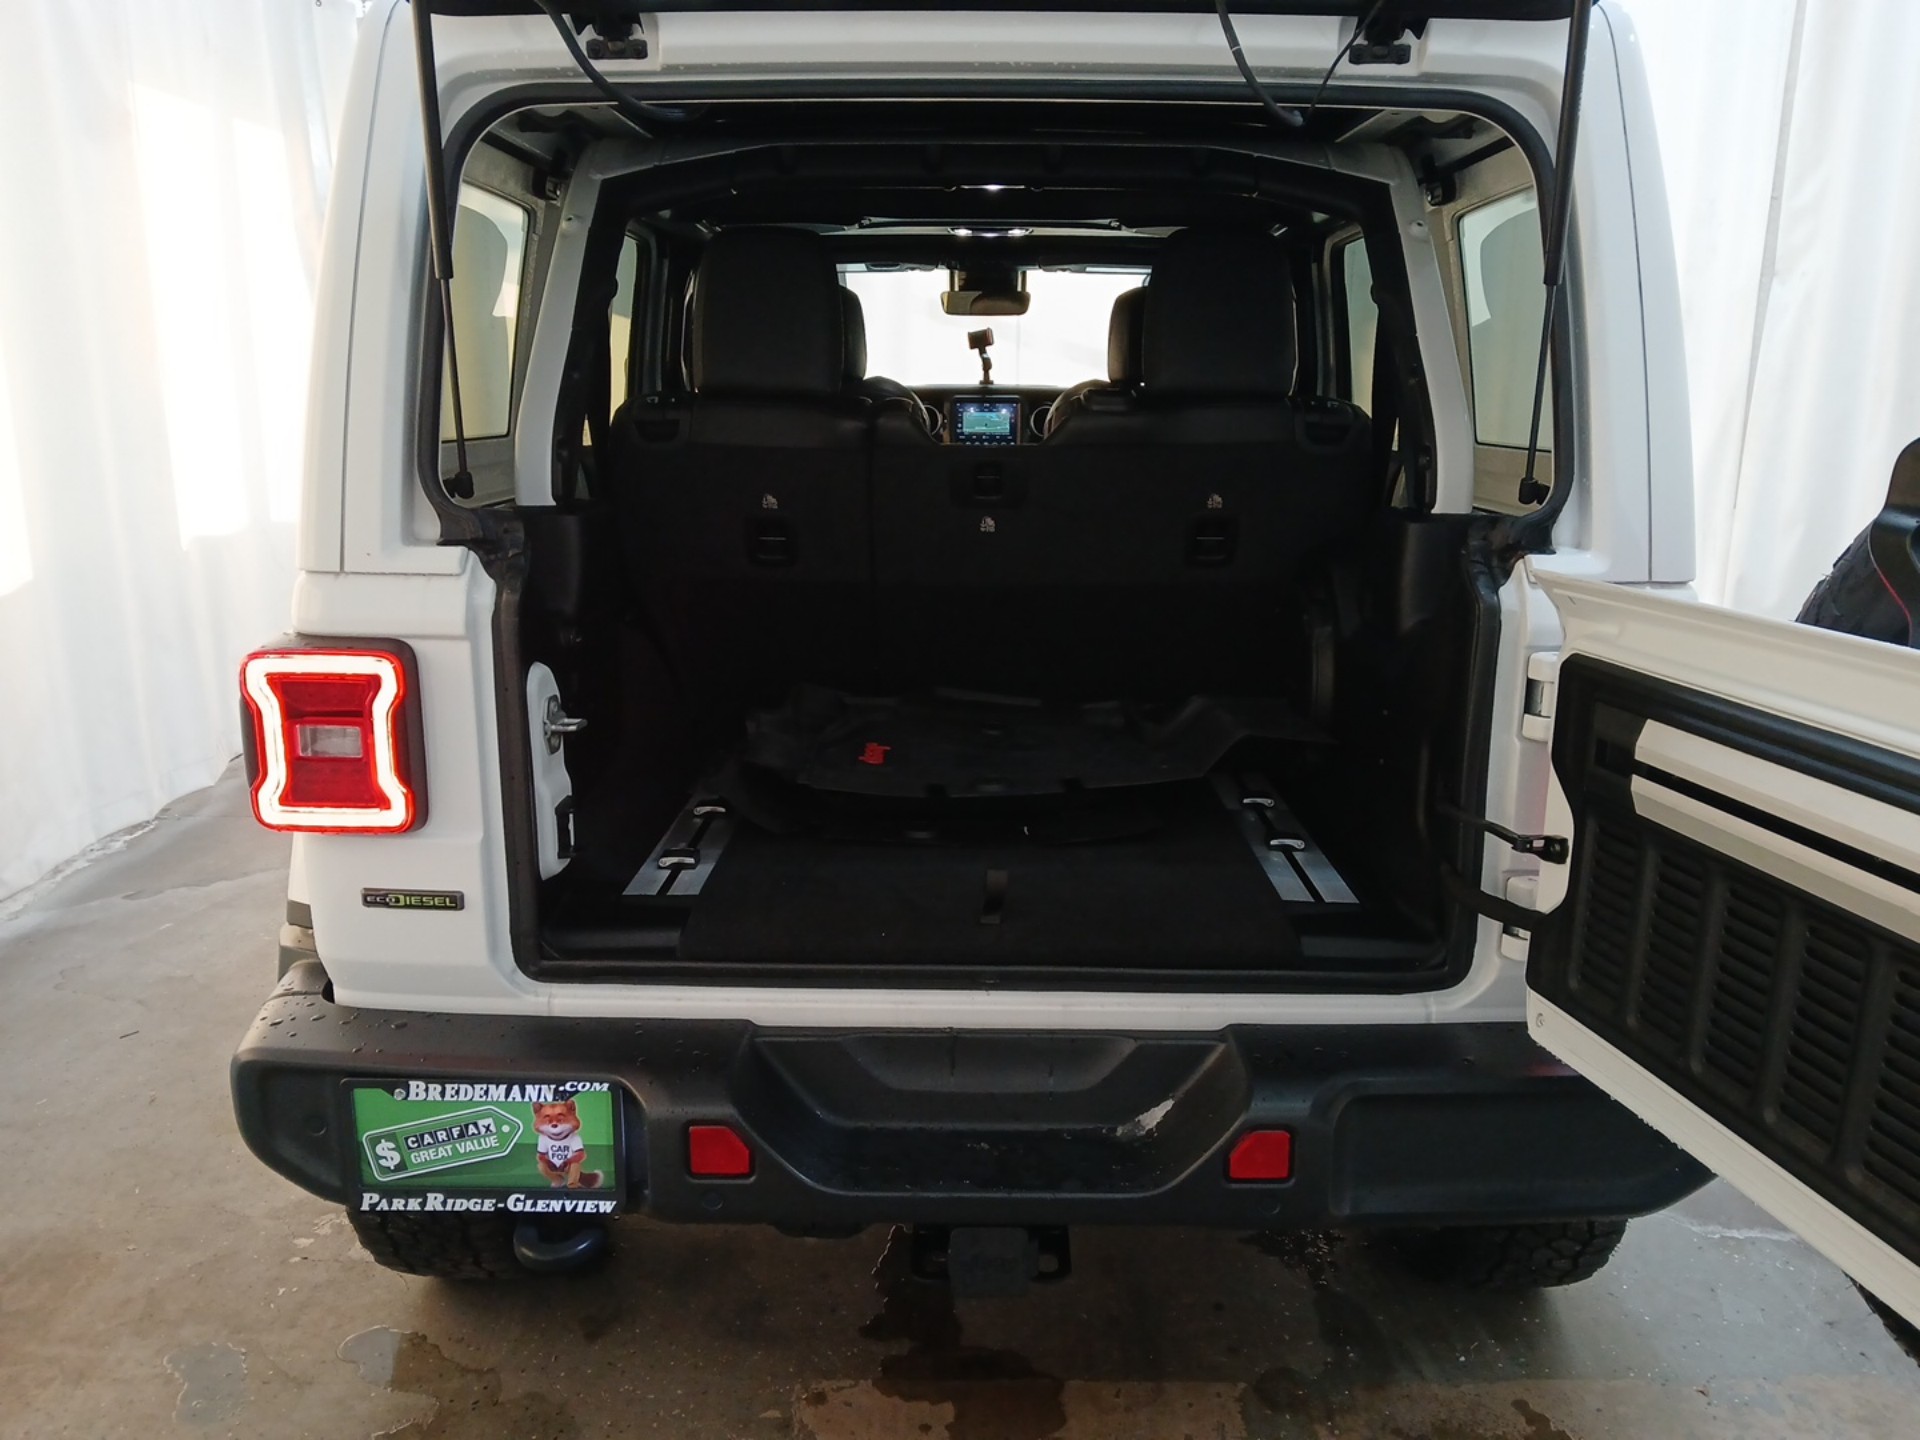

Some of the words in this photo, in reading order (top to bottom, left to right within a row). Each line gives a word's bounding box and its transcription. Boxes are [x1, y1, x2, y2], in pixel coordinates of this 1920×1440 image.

[405, 1120, 496, 1149] CARFAX
[550, 1144, 570, 1153] CAR
[375, 1139, 401, 1169] $
[411, 1145, 453, 1164] GREAT
[457, 1135, 500, 1155] VALUE
[551, 1152, 570, 1161] FOX
